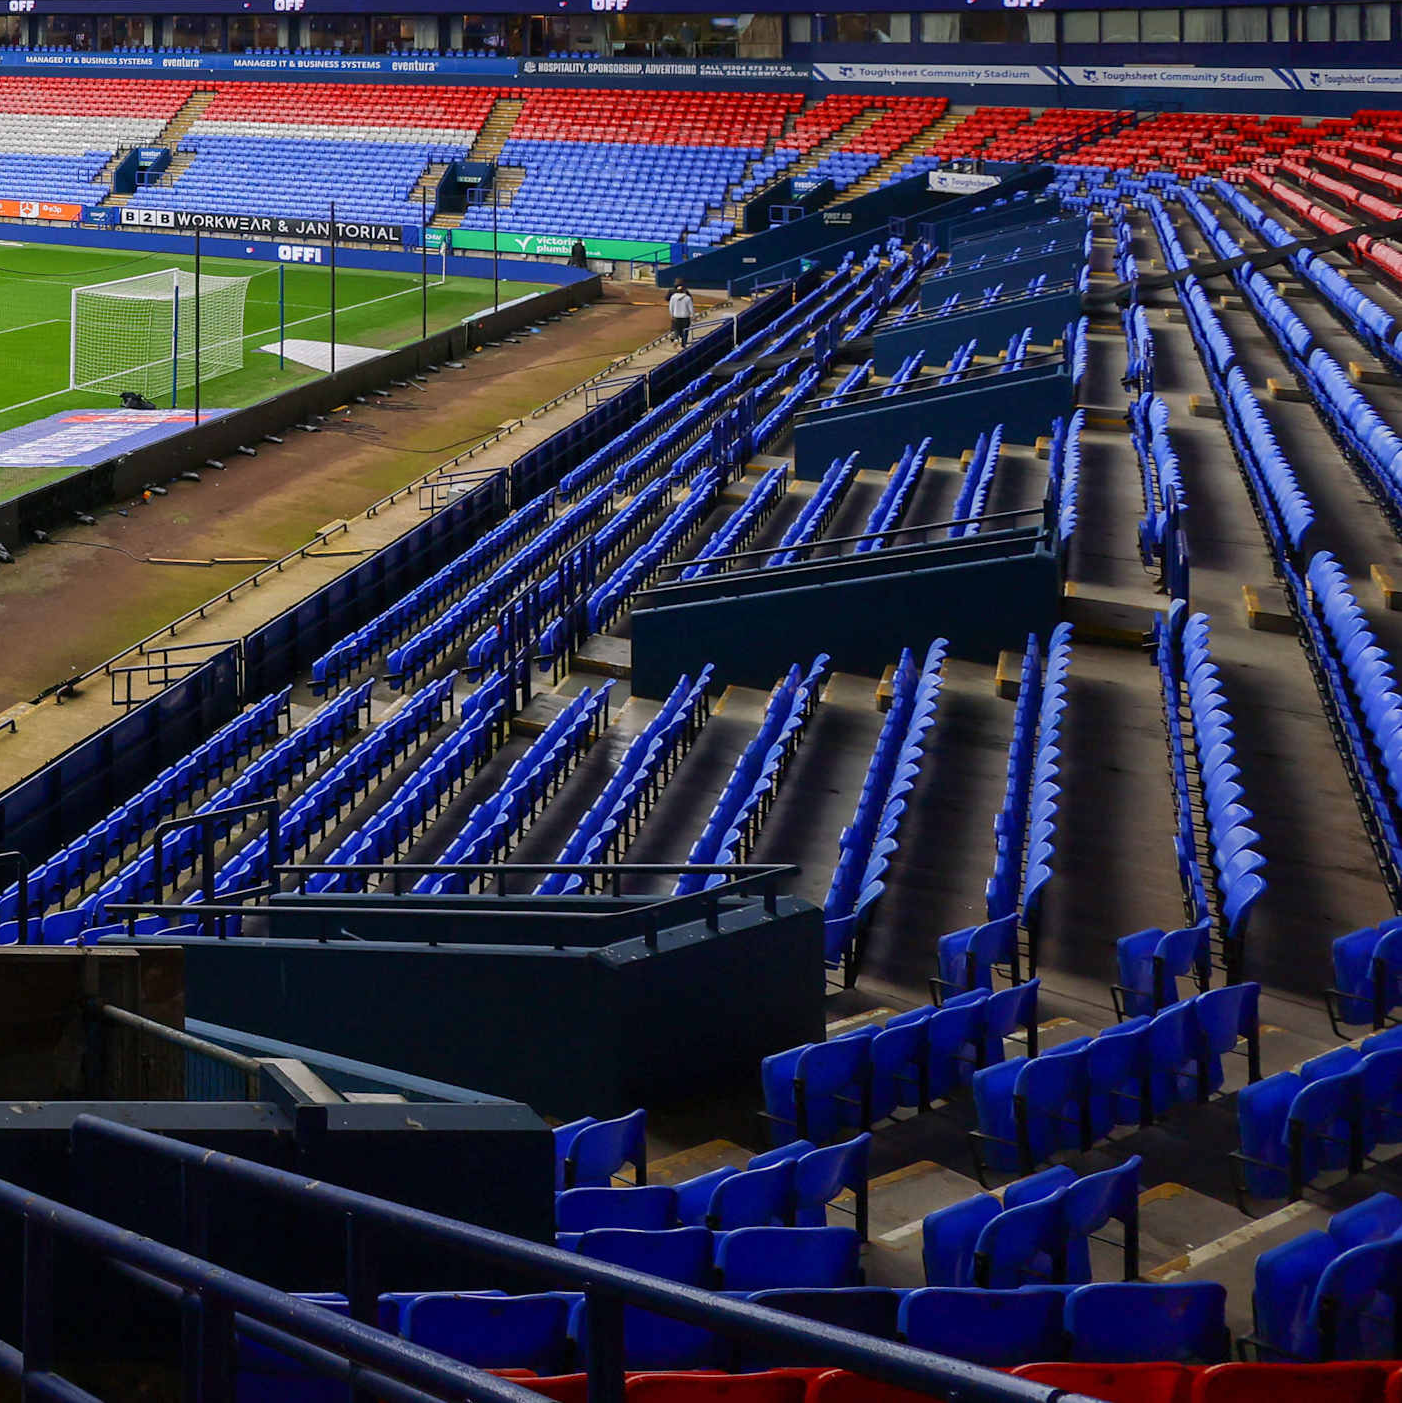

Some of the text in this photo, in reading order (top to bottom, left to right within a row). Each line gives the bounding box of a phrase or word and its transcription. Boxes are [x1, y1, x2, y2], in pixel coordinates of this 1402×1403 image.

[9, 0, 35, 12] OFF
[26, 56, 64, 64] MANAGED
[81, 57, 117, 65] BUSINESS
[119, 57, 153, 66] SYSTEMS
[233, 59, 277, 68] MANAGED
[279, 60, 288, 68] IT
[298, 60, 339, 69] BUSINESS
[341, 61, 381, 70] SYSTEMS
[392, 61, 435, 72] eventura
[538, 62, 697, 76] HOSPITALITY, SPONSORSHIP, ADVERTISING
[859, 67, 1030, 79] Toughsheet Community Stadium
[1102, 71, 1265, 84] Toughsheet Community Stadium
[278, 221, 289, 233] &
[296, 222, 399, 241] JANTORIAL
